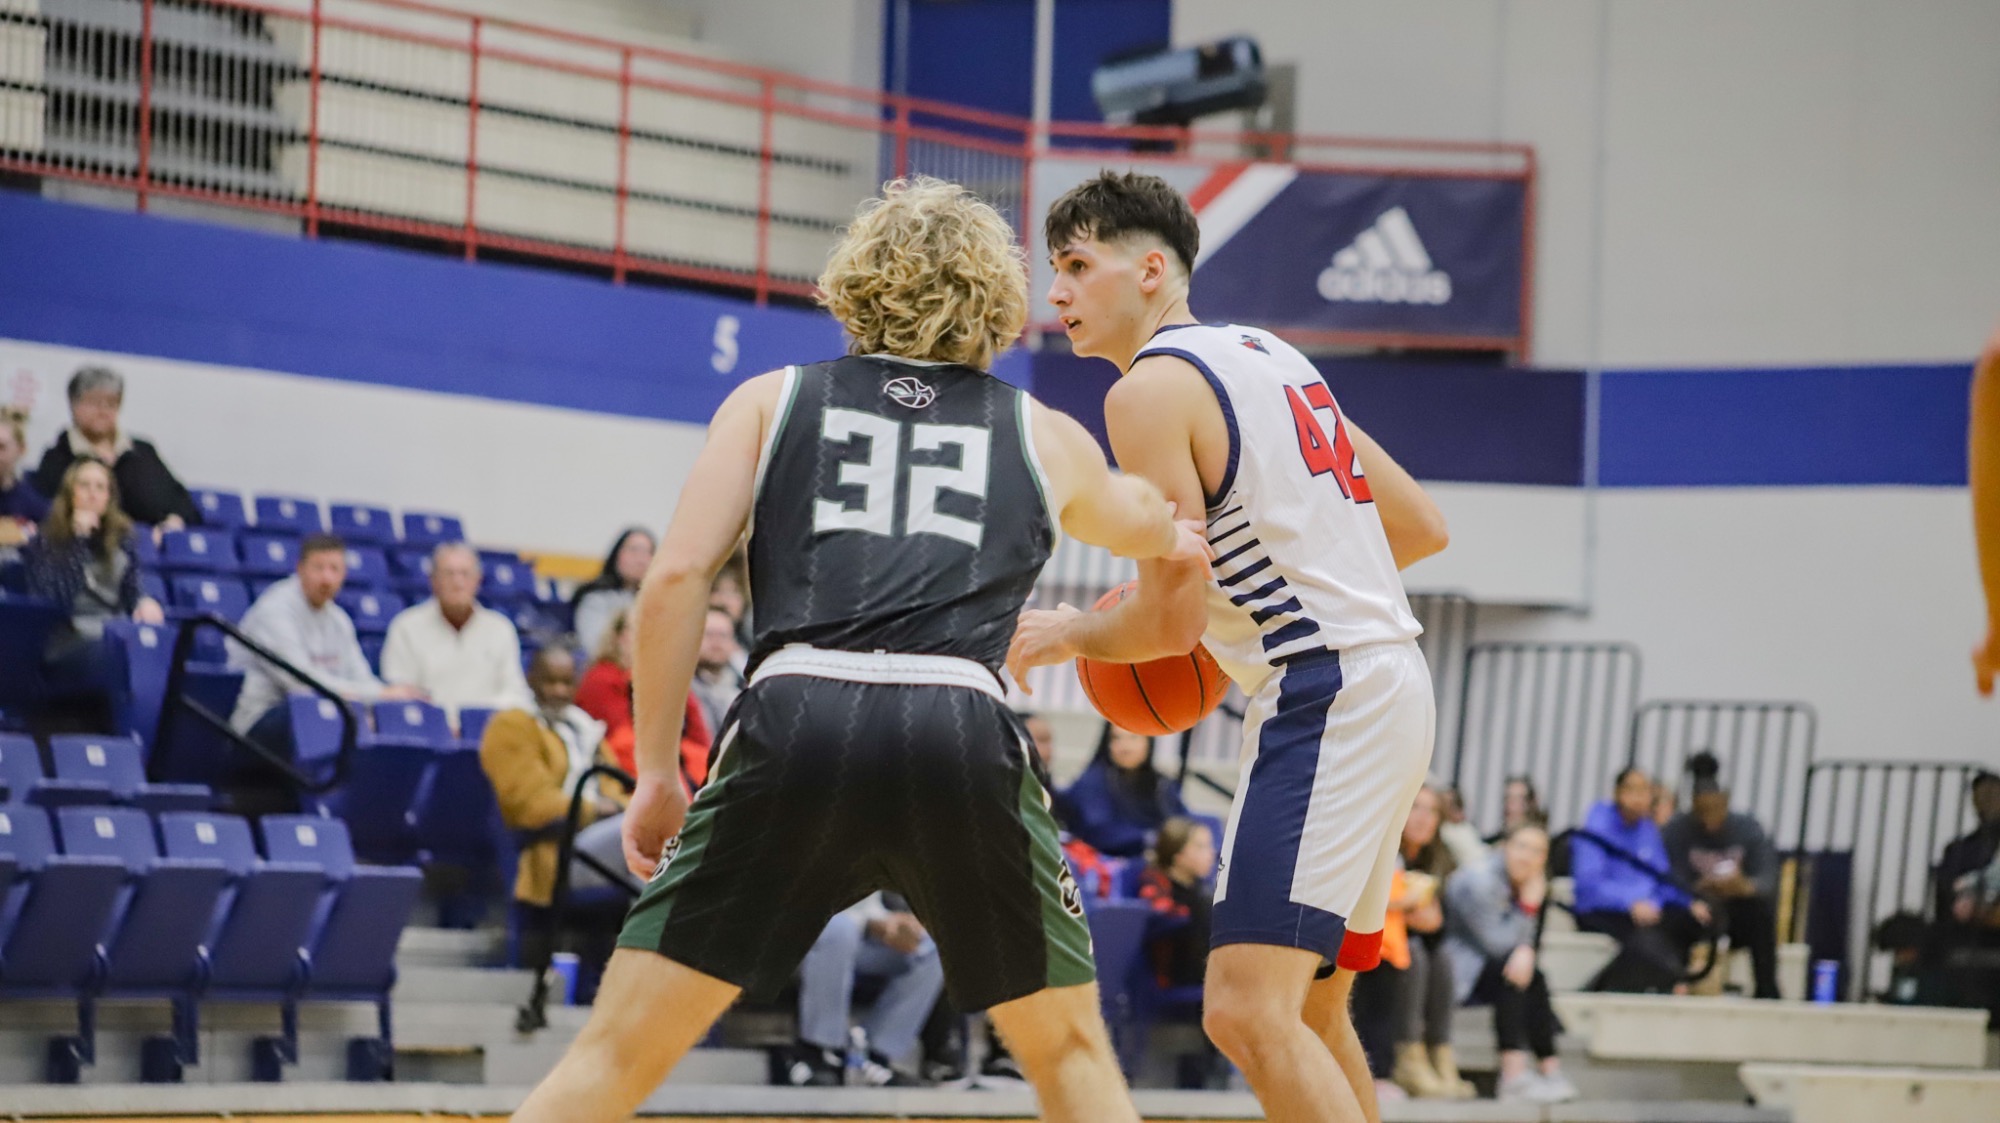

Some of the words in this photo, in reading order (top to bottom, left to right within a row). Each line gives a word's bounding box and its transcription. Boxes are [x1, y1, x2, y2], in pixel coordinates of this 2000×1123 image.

[711, 315, 740, 374] 5
[813, 406, 993, 551] 32
[1283, 381, 1374, 504] 42
